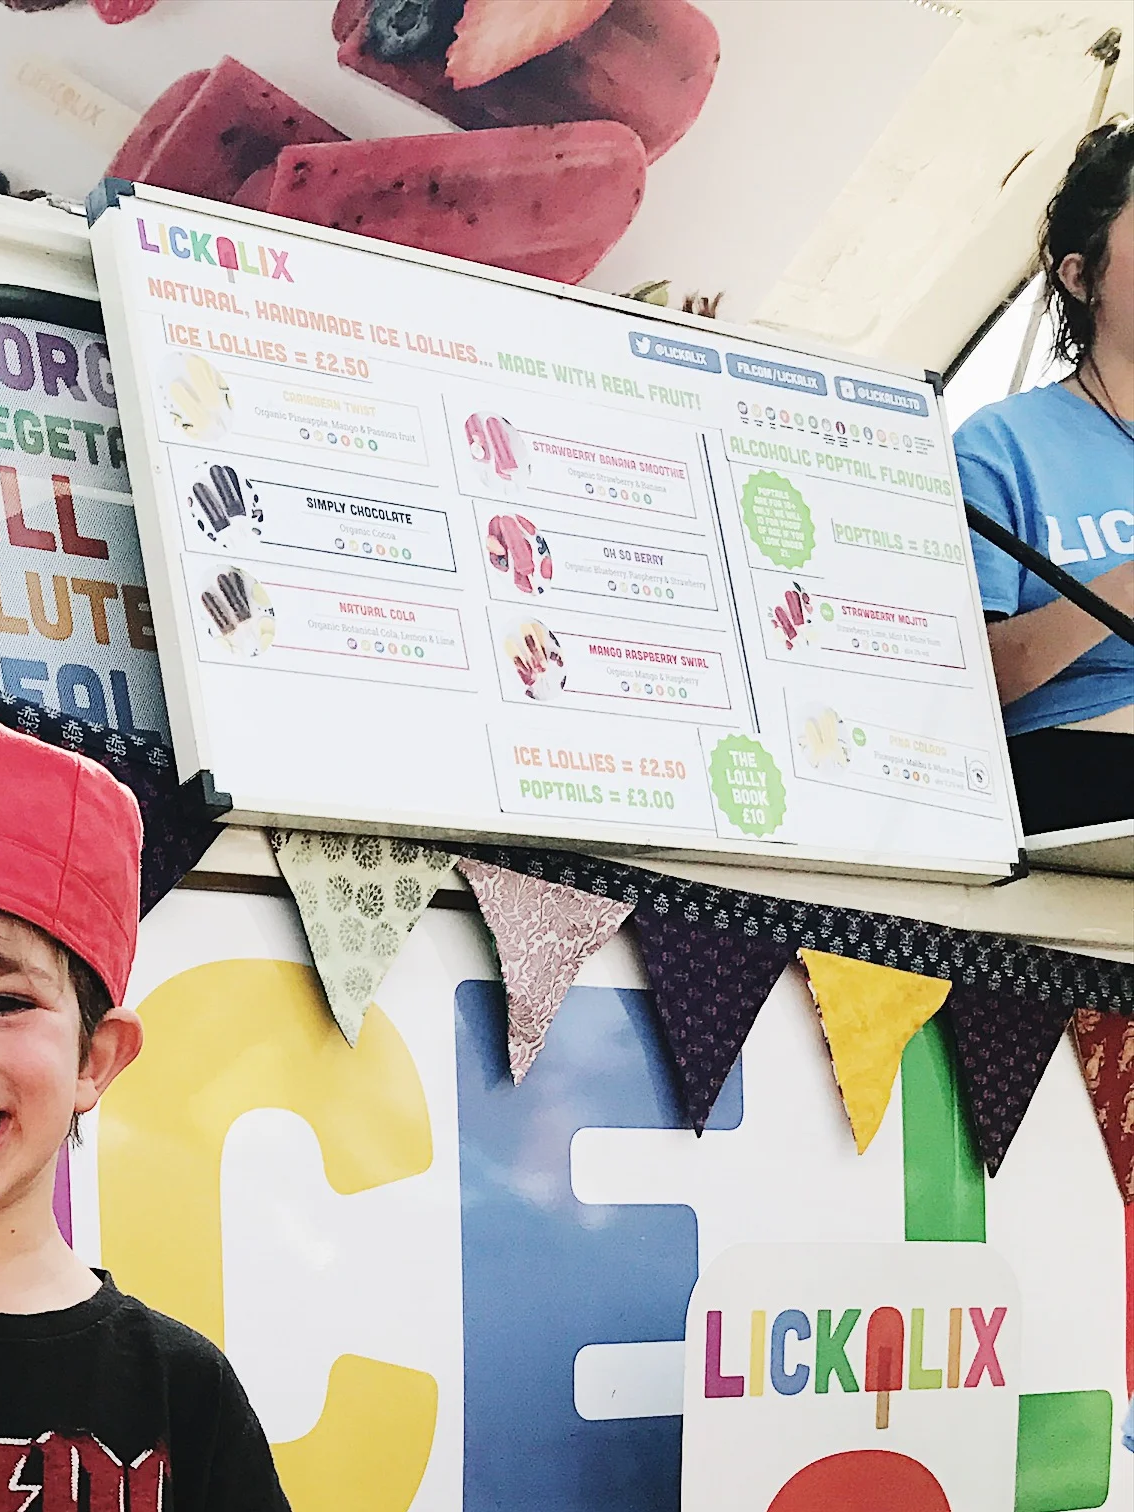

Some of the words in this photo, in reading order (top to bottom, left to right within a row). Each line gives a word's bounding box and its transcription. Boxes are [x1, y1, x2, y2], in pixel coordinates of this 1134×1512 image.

[147, 276, 250, 319] NATURAL,
[255, 300, 365, 340] HANDMADE
[369, 323, 401, 349] ICE
[497, 351, 549, 379] MADE
[551, 362, 597, 390] WITH
[601, 373, 645, 400] REAL
[647, 383, 702, 411] FRUIT!
[167, 322, 202, 348] ICE
[207, 329, 288, 363] LOLLIES
[315, 350, 370, 380] £2.50
[654, 342, 708, 367] @LICKALIX
[736, 361, 819, 390] FB.COM/LICKALIX
[254, 406, 288, 422] Organic
[331, 420, 359, 434] Mango
[532, 440, 596, 464] STRAWBERRY
[599, 454, 637, 471] BANANA
[638, 461, 686, 480] SMOOTHIE
[729, 435, 812, 468] ALCOHOLIC
[815, 451, 877, 481] POPTAIL
[567, 467, 596, 481] Organic
[596, 472, 635, 489] Strawberry
[306, 496, 347, 514] SIMPLY
[350, 503, 413, 525] CHOCOLATE
[339, 522, 372, 537] Organic
[834, 523, 903, 551] POPTAILS
[922, 537, 963, 561] £3.00
[603, 547, 618, 559] OH
[618, 550, 632, 561] SO
[634, 552, 664, 566] BERRY
[339, 601, 387, 618] NATURAL
[389, 608, 417, 623] COLA
[841, 604, 895, 624] STRAWBERRY
[898, 613, 929, 628] MOJITO
[307, 618, 340, 632] Organic
[589, 644, 622, 659] MANGO
[624, 648, 678, 666] RASPBERRY
[680, 655, 710, 669] SWIRL
[513, 745, 543, 767] ICE
[546, 748, 617, 774] LOLLIES
[639, 757, 687, 780] £2.50
[728, 750, 757, 768] THE
[725, 767, 767, 788] LOLLY
[518, 779, 603, 805] POPTAILS
[626, 787, 675, 810] £3.00
[731, 786, 770, 806] BOOK
[742, 807, 766, 826] £10
[704, 1306, 1008, 1429] LICKALIX
